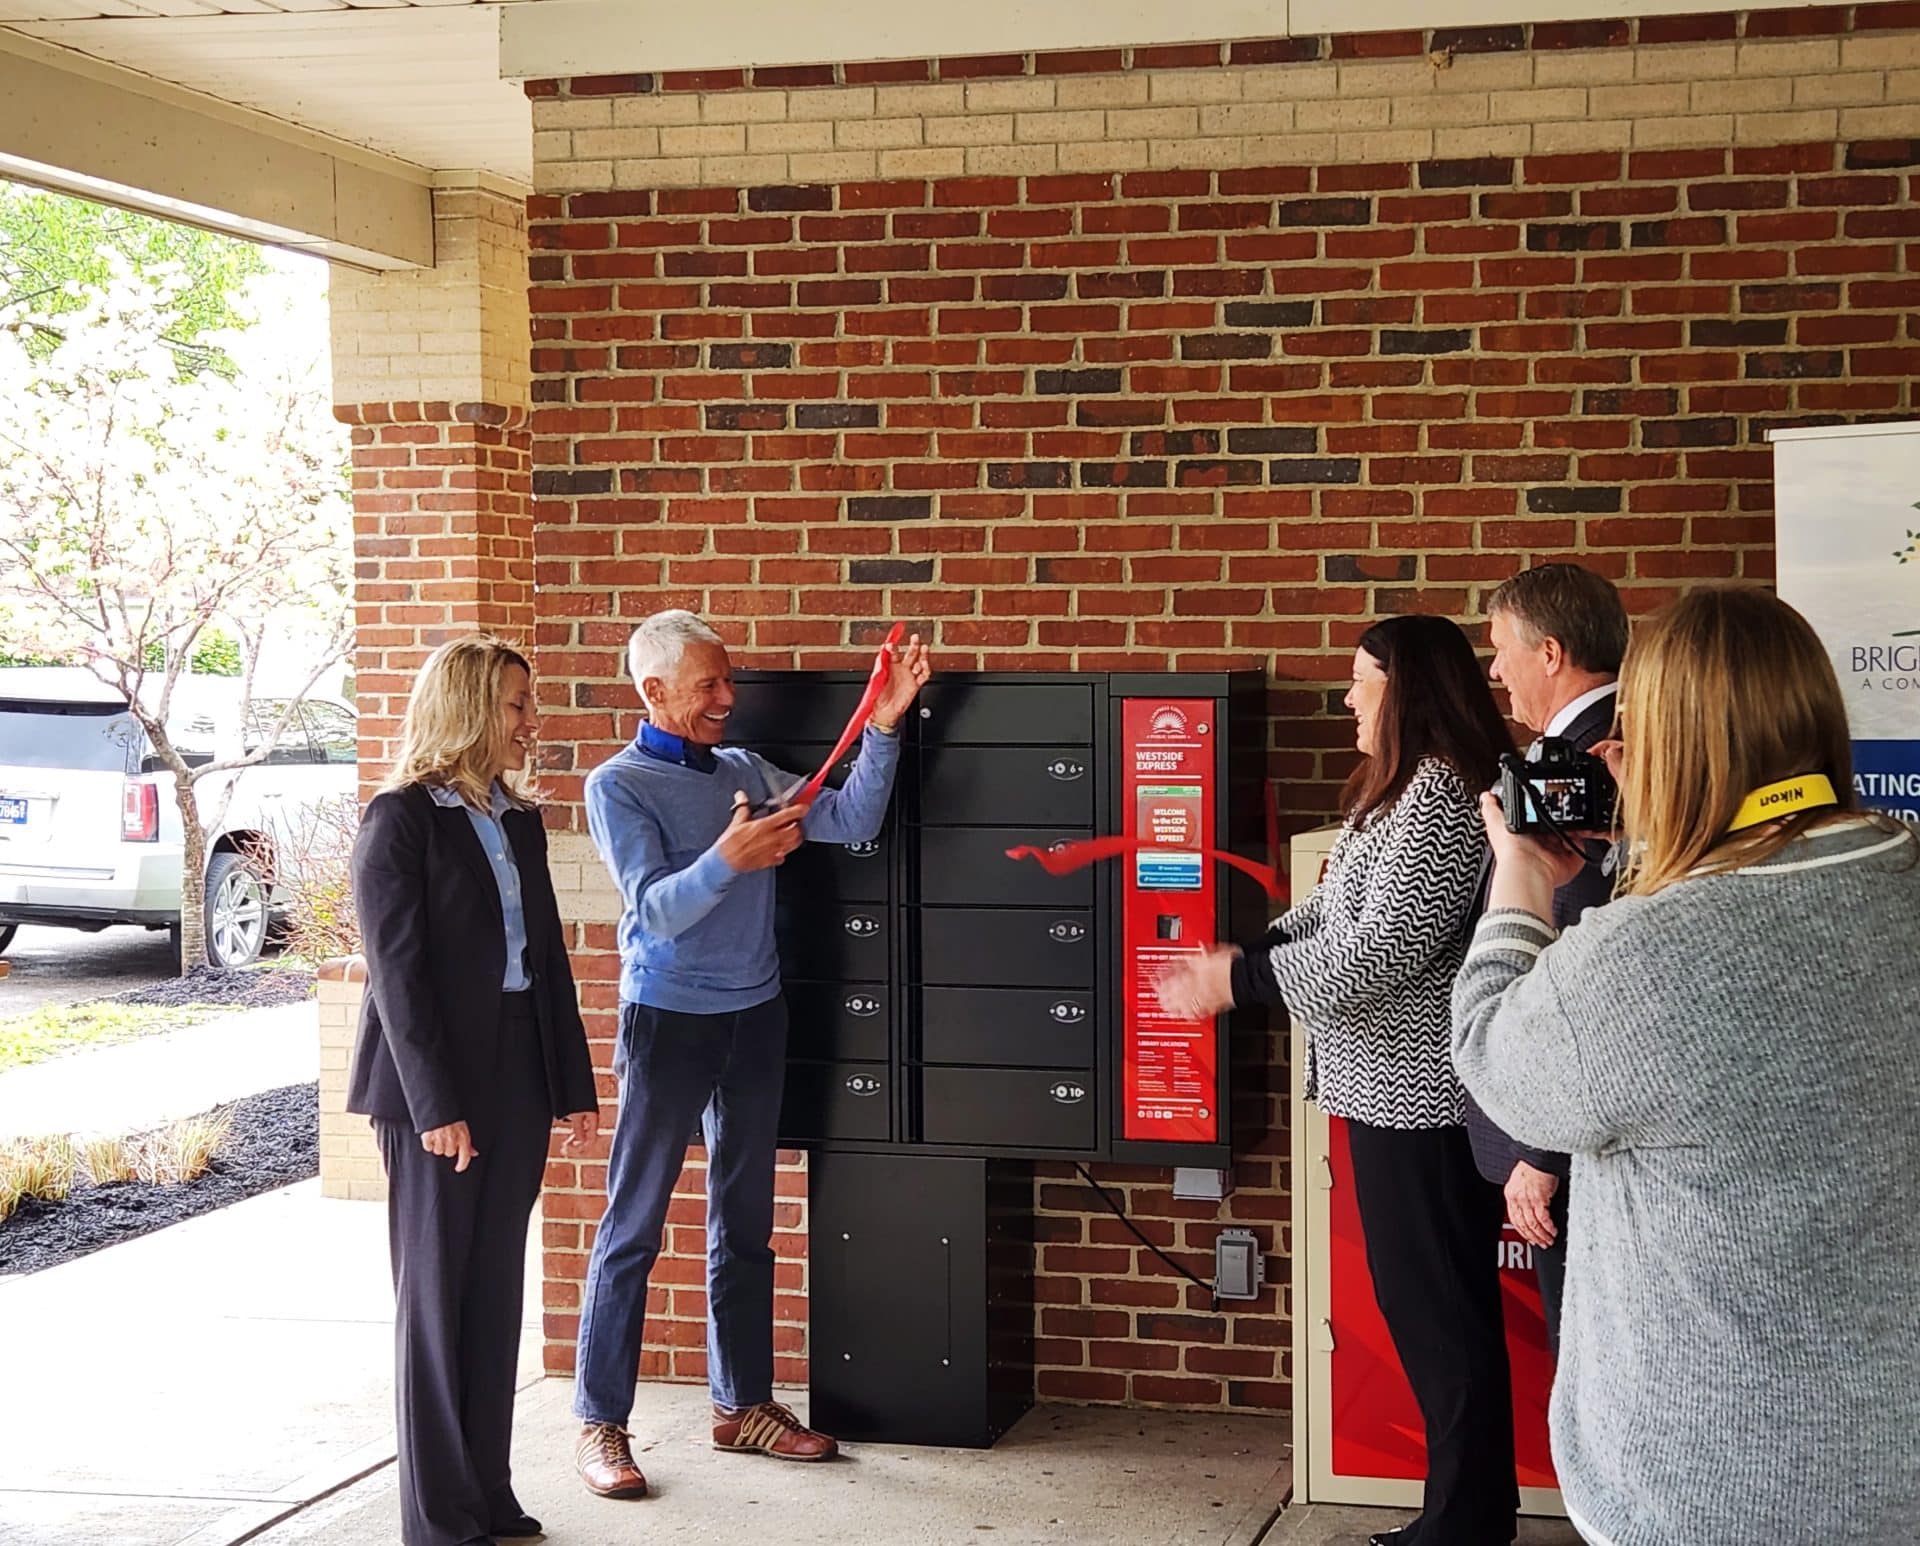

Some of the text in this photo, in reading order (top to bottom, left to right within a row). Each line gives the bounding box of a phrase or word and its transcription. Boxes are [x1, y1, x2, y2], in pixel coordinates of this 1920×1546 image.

[1852, 645, 1920, 672] BRIG
[1862, 677, 1872, 690] A
[1136, 752, 1184, 761] WESTSIDE
[1070, 764, 1076, 773] 6
[1136, 761, 1177, 770] EXPRESS
[1853, 773, 1920, 797] ATING
[1760, 786, 1804, 807] Nikon
[1153, 808, 1186, 816] WELCOME
[865, 841, 872, 851] 2
[865, 921, 872, 931] 3
[1070, 926, 1077, 936] 8
[866, 1000, 873, 1010] 4
[1071, 1006, 1078, 1017] 9
[867, 1080, 874, 1089] 5
[1069, 1087, 1081, 1098] 10
